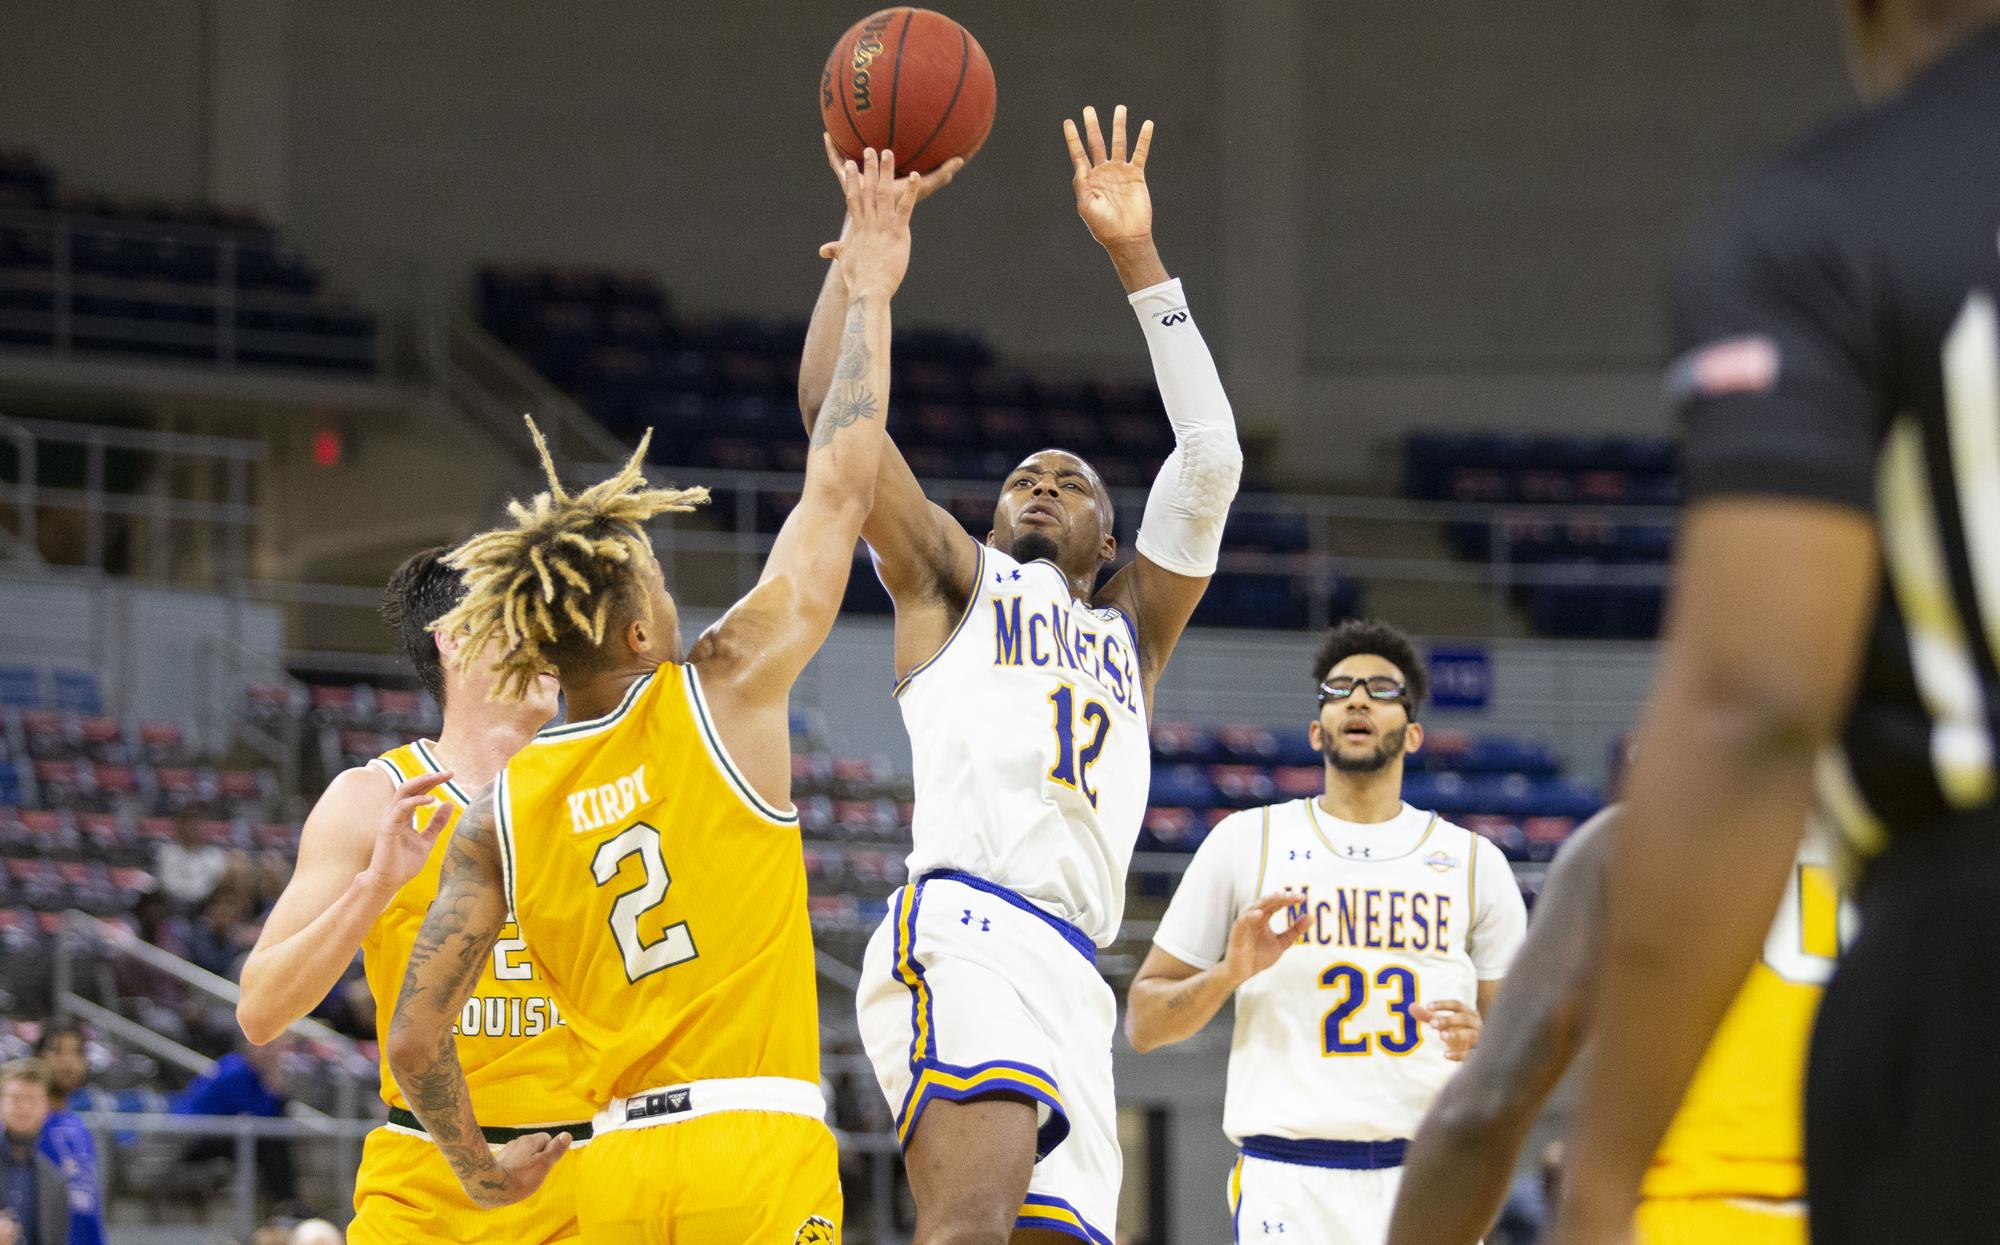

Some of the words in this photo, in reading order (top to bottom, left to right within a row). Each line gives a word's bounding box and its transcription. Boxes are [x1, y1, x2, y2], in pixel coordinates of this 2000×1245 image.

[566, 764, 650, 834] KIRBY
[1047, 681, 1112, 816] 12
[589, 820, 700, 986] 2
[1317, 961, 1424, 1058] 23
